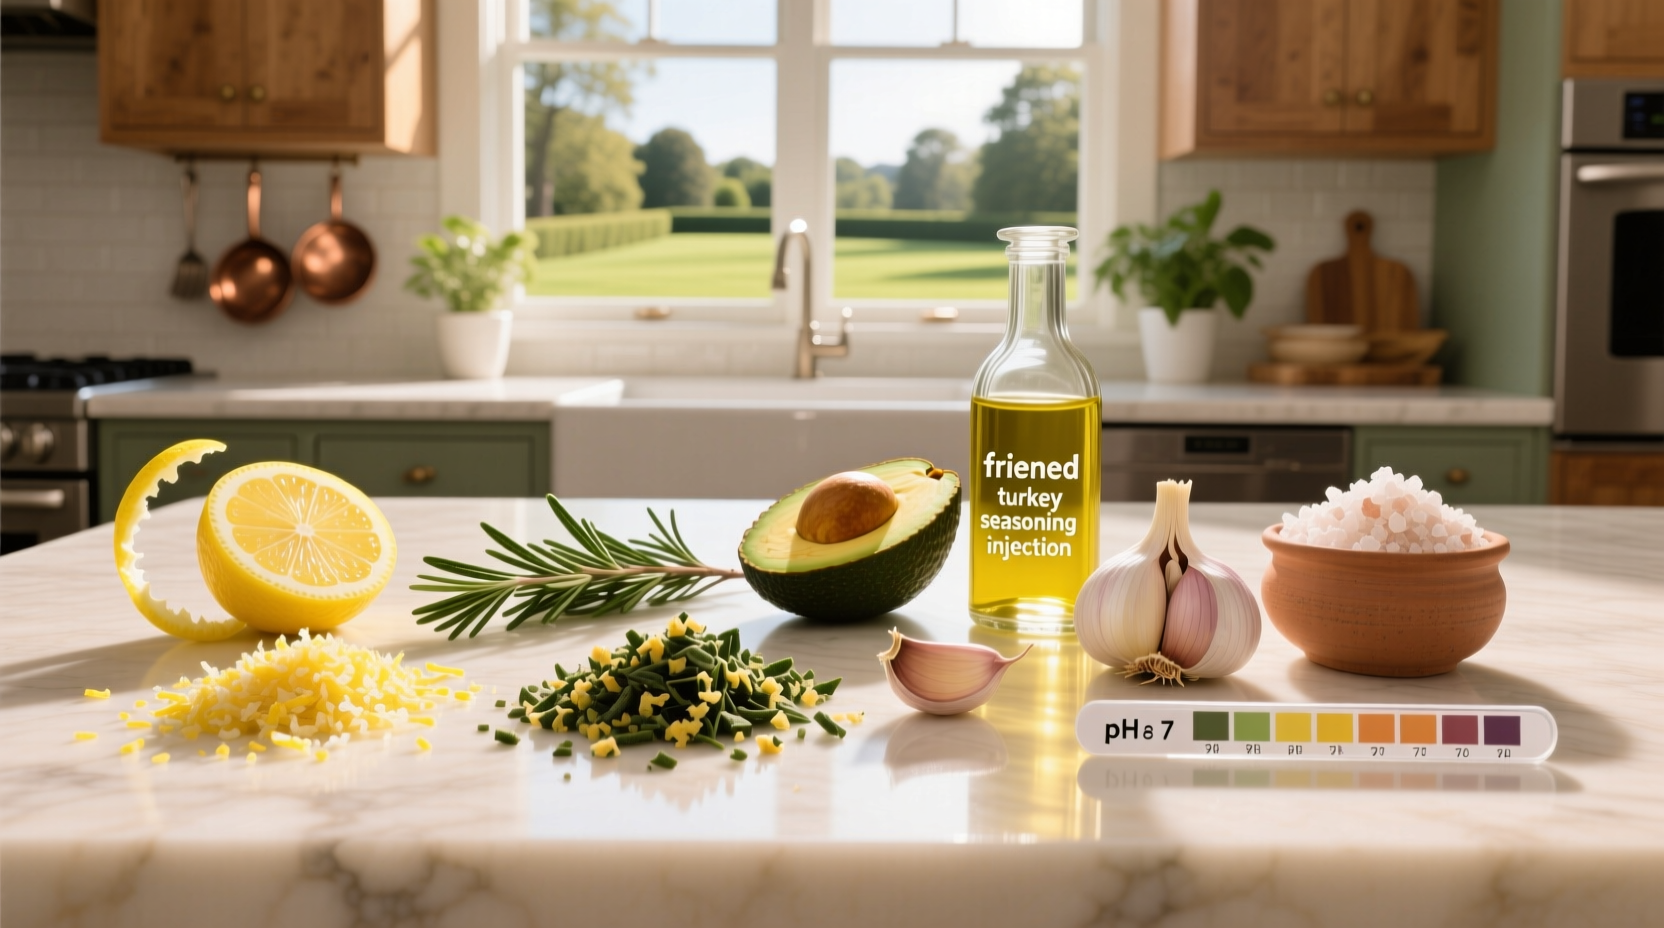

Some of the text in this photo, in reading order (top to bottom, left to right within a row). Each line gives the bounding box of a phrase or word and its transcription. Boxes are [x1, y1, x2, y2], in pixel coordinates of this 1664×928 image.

[983, 451, 1080, 480] friened
[997, 486, 1063, 513] turkey
[980, 512, 1077, 536] seasoning
[987, 535, 1072, 561] injection
[1161, 720, 1174, 740] 7
